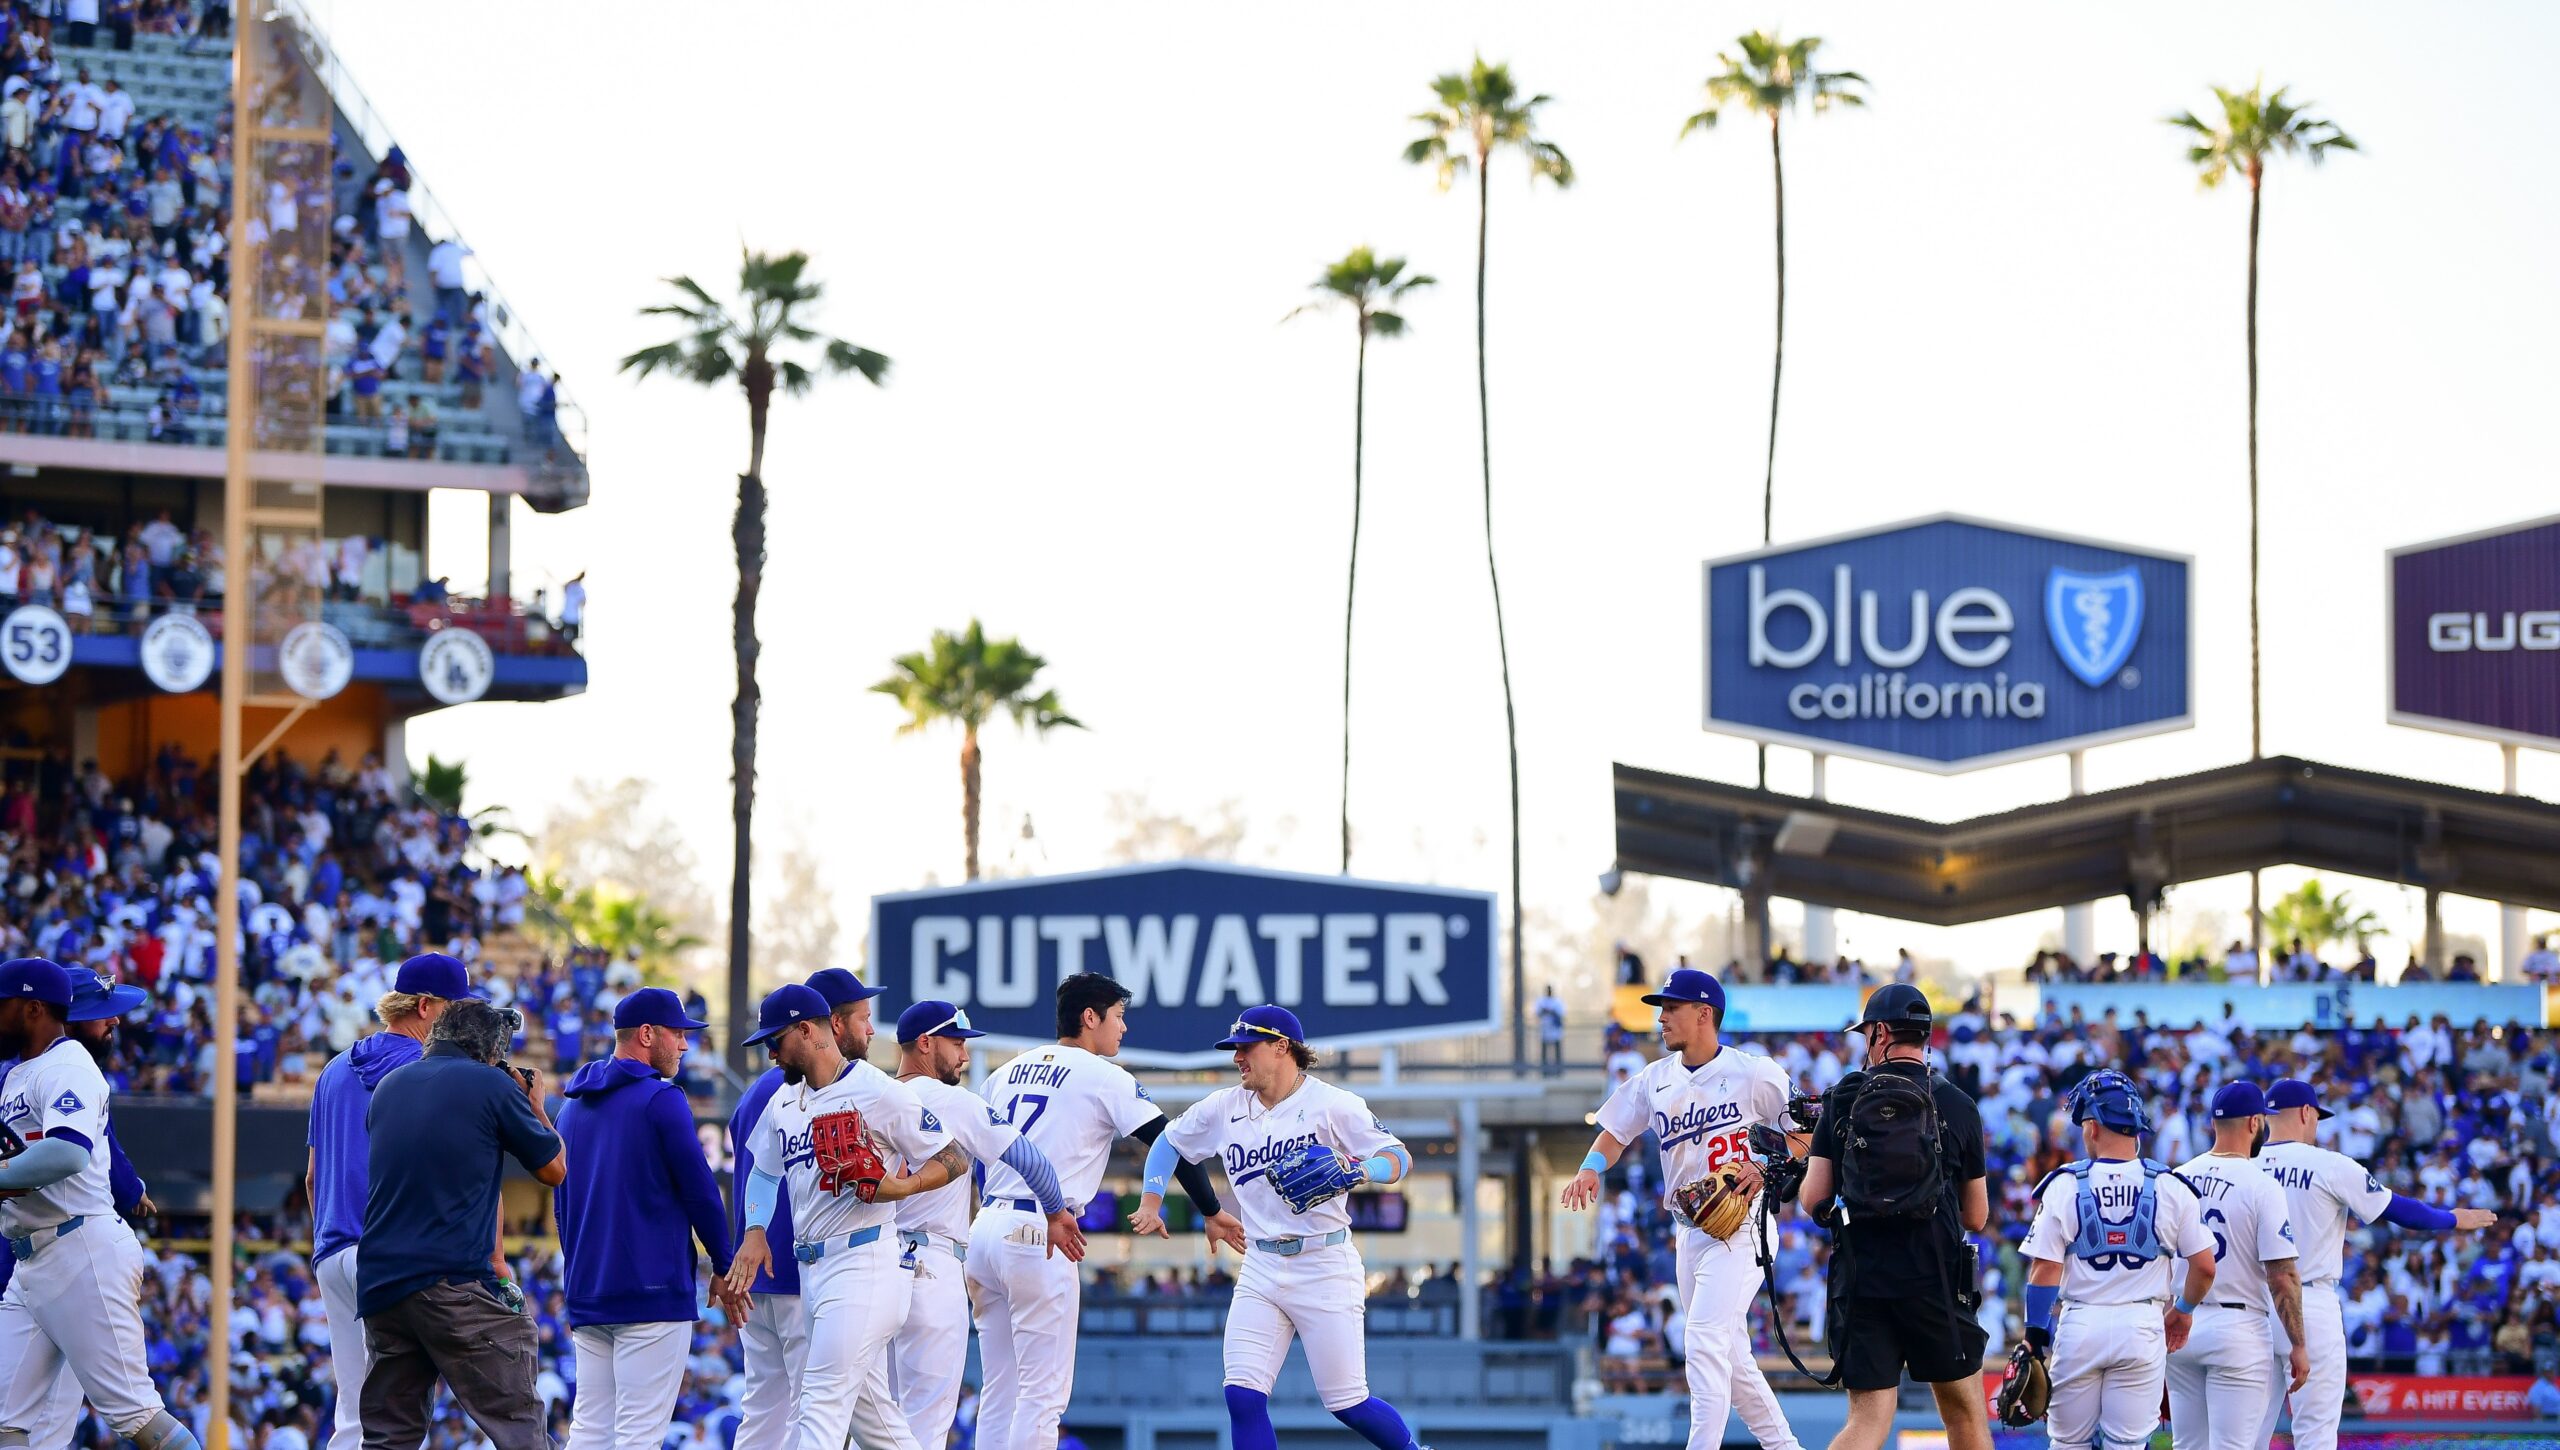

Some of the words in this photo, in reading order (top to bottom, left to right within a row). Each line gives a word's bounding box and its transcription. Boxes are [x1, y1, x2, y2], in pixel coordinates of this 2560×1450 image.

[1748, 563, 2015, 669] blue
[2428, 611, 2560, 652] GUG
[12, 625, 60, 662] 53
[1788, 672, 2046, 720] california
[911, 913, 1449, 1009] CUTWATER
[1008, 1063, 1071, 1089] OHTANI
[1007, 1093, 1049, 1136] 17
[1656, 1102, 1743, 1151] Dodgers
[1708, 1131, 1750, 1173] 25
[2263, 1167, 2314, 1191] MAN
[2402, 1389, 2418, 1411] A
[2422, 1389, 2459, 1411] HIT
